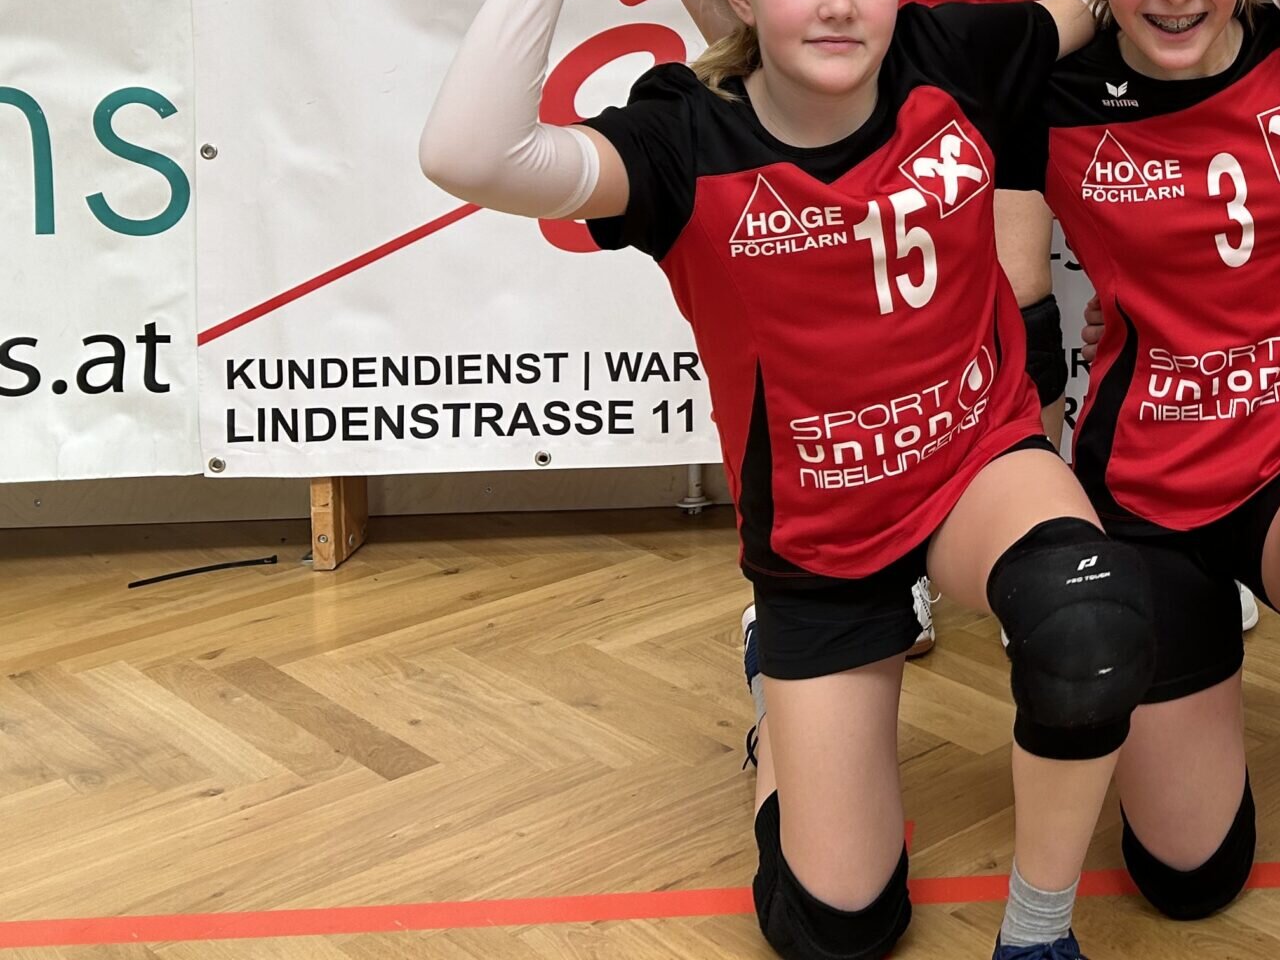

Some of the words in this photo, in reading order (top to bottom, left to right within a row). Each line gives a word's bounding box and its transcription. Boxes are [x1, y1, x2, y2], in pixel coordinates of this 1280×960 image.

[1082, 184, 1185, 204] PÖCHLARN
[1206, 152, 1255, 268] 3
[730, 230, 848, 258] PÖCHLARN
[853, 187, 938, 315] 15
[226, 351, 569, 390] KUNDENDIENST
[605, 351, 702, 382] WAR
[1149, 366, 1280, 401] union
[227, 400, 635, 443] LINDENSTRASSE
[652, 398, 693, 434] 11
[790, 380, 949, 441] SPORT
[796, 410, 953, 465] union
